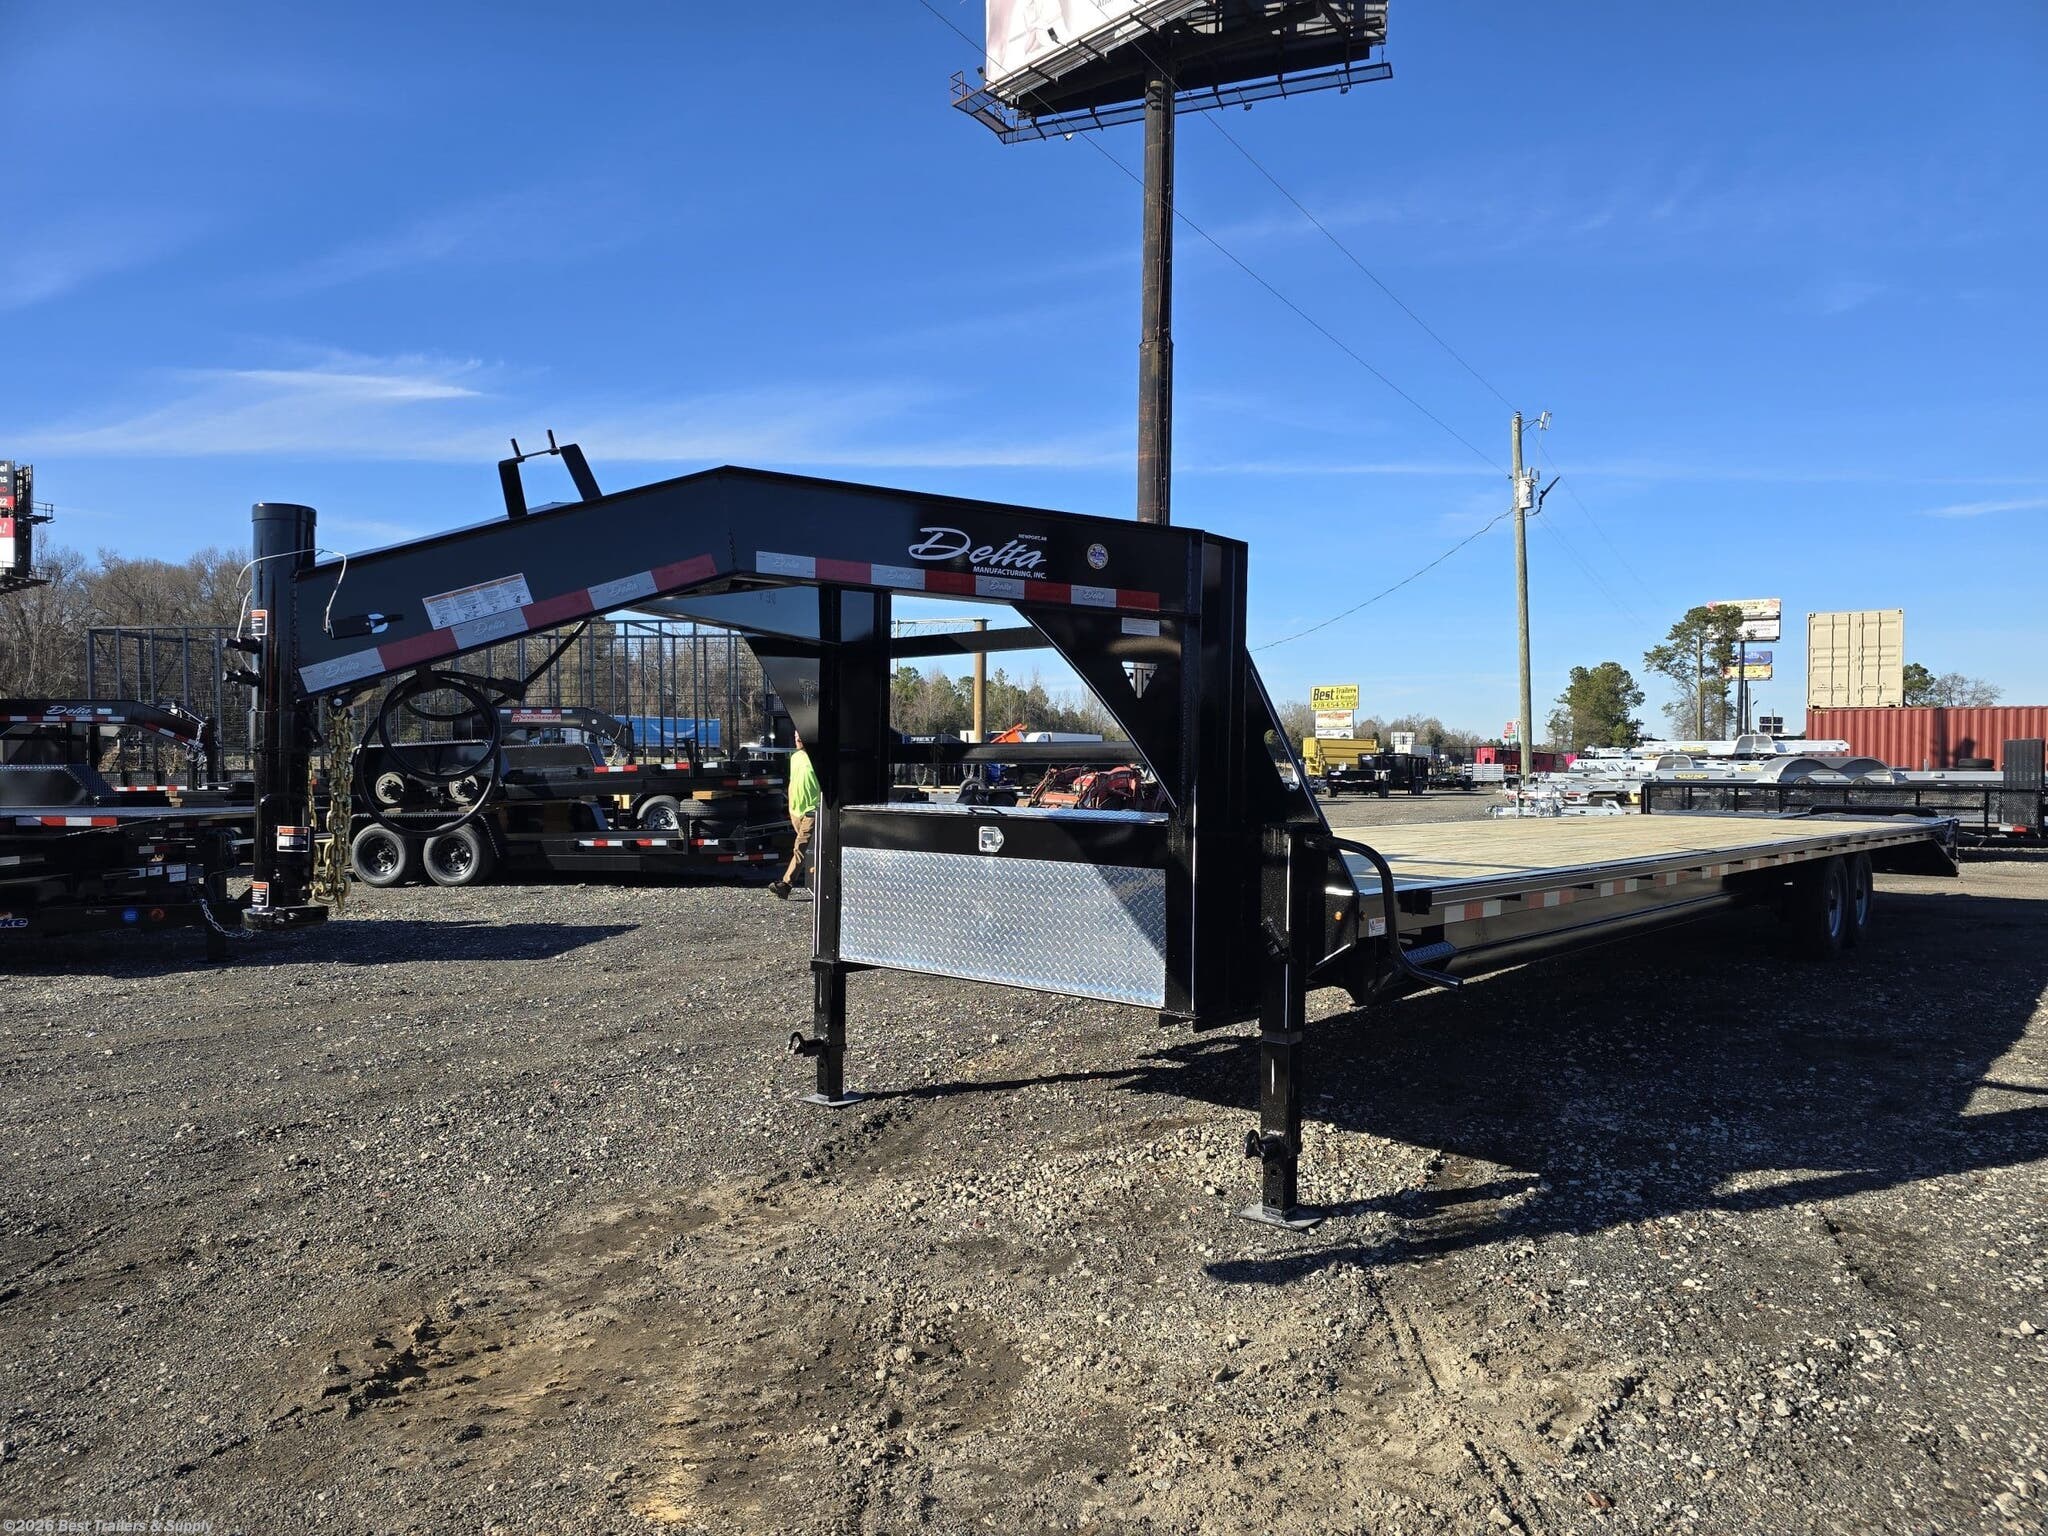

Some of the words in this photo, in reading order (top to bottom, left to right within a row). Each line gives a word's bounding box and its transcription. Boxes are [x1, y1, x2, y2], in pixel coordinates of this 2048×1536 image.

[908, 527, 1047, 569] Delta
[973, 565, 1033, 579] MANUFACTURING,
[1033, 571, 1047, 580] INC.
[1313, 688, 1335, 701] Best
[46, 705, 92, 716] Delta
